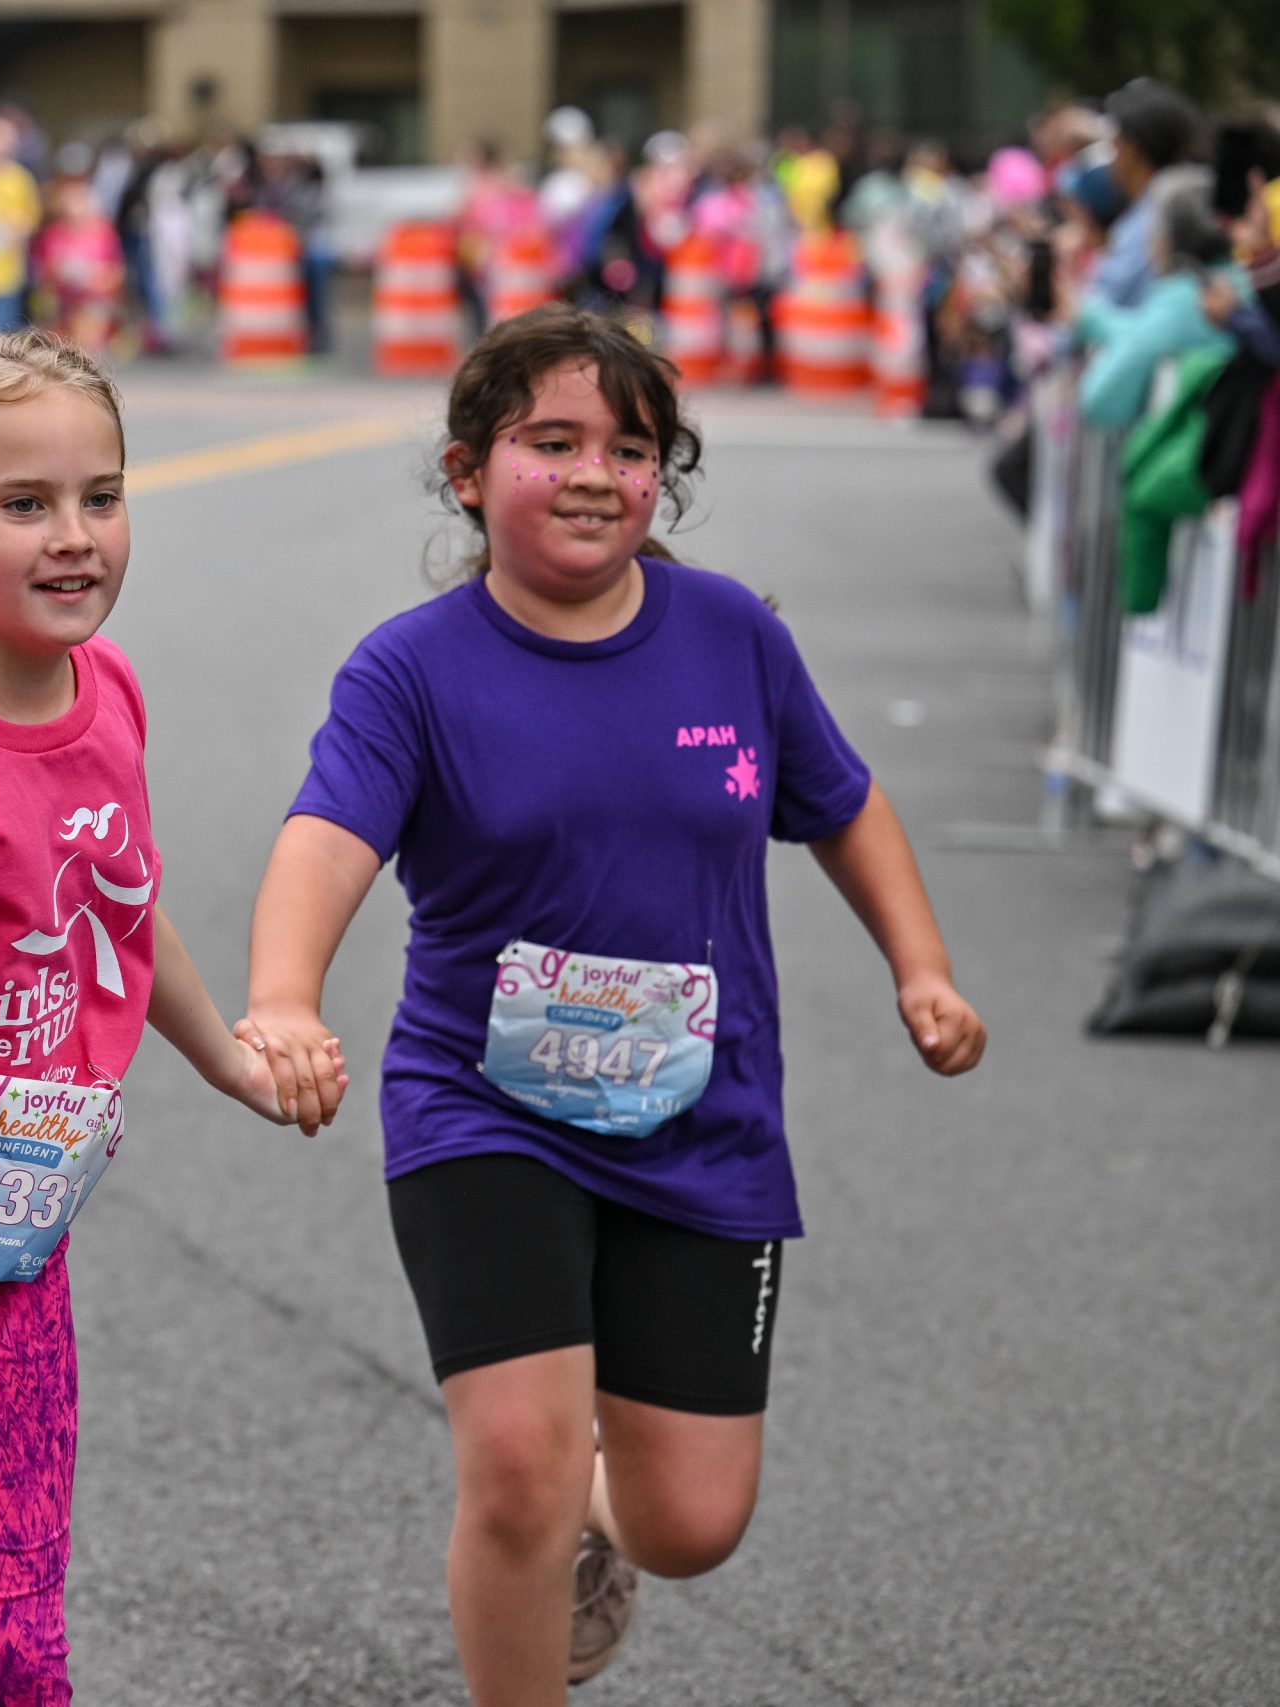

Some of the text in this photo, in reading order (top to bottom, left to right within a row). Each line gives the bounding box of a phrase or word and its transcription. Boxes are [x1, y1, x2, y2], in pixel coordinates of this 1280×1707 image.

[676, 725, 737, 747] APAH
[582, 965, 641, 986] joyful
[65, 976, 79, 1000] o
[558, 981, 646, 1017] healthy
[551, 1008, 620, 1027] CONFIDENT
[10, 999, 78, 1067] run
[529, 1029, 670, 1088] 4947
[22, 1090, 86, 1115] joyful
